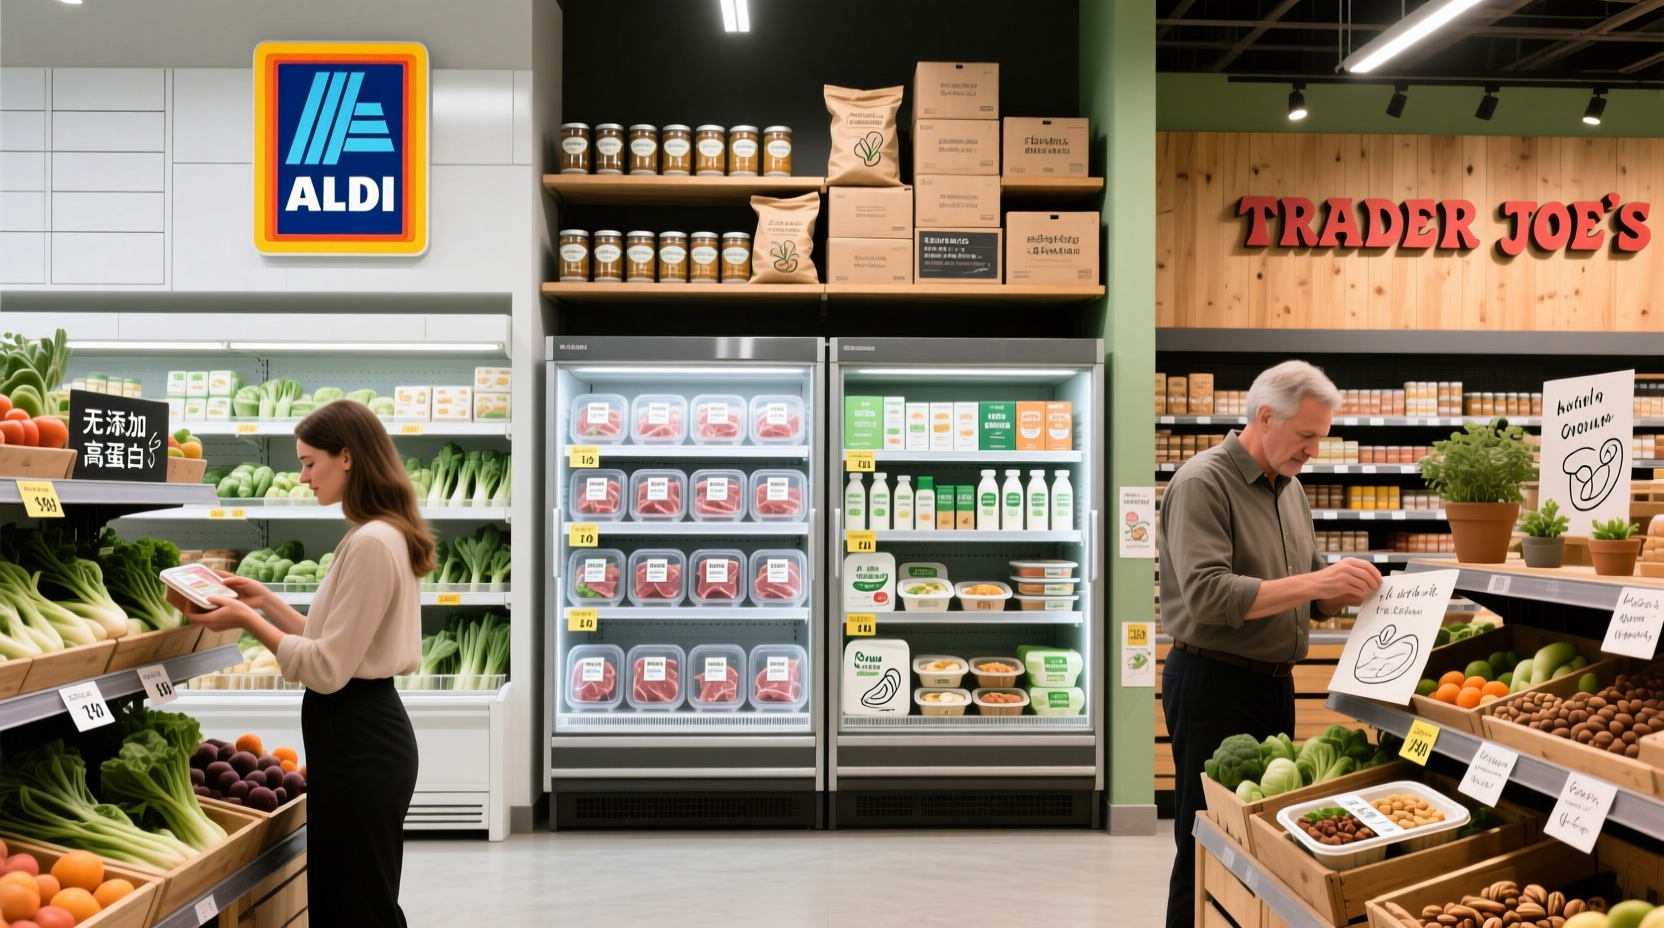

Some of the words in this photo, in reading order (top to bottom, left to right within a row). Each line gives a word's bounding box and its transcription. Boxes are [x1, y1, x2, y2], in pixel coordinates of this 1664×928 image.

[285, 176, 395, 212] ALDI
[1237, 195, 1480, 250] TRADER
[1496, 191, 1652, 257] JOE'S
[82, 408, 147, 438] 无添加
[83, 439, 144, 469] 高蛋白
